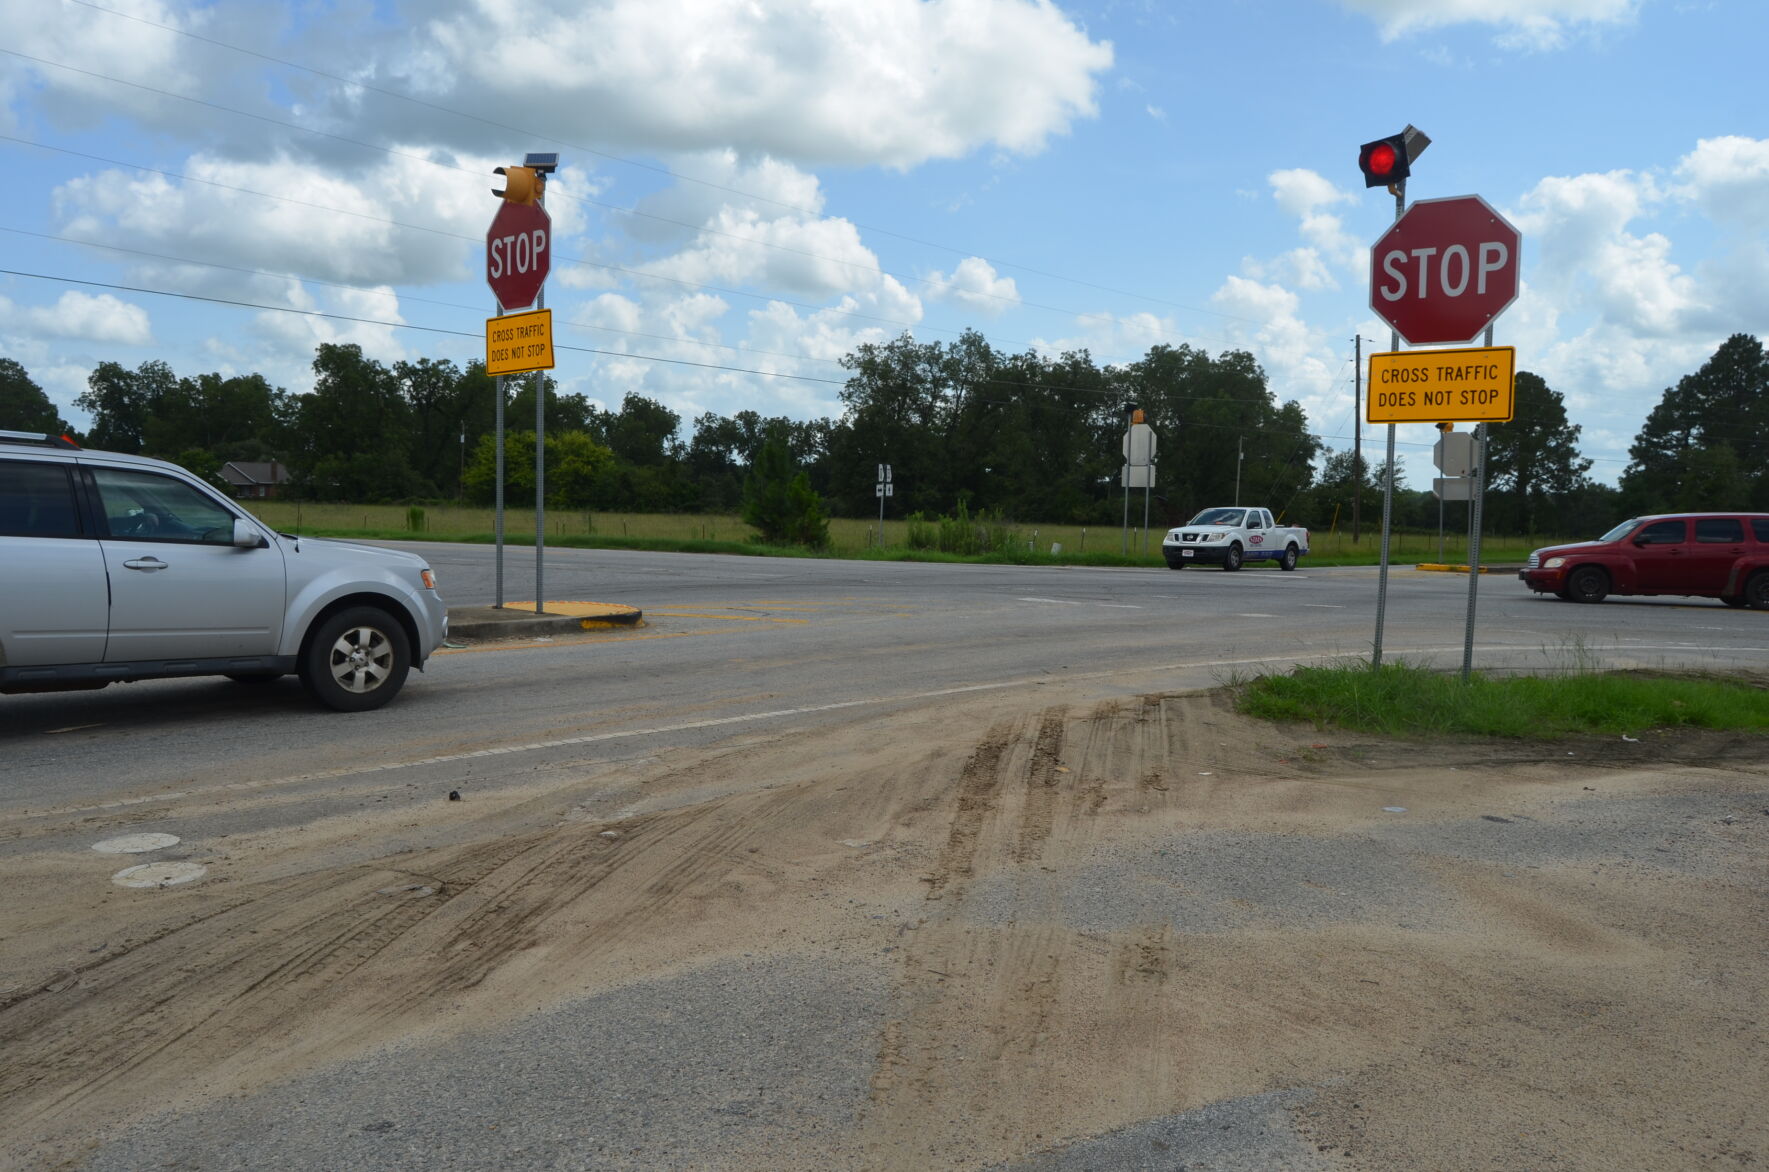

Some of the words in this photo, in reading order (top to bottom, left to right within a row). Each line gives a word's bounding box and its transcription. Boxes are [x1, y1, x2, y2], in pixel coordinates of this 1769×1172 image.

[490, 229, 546, 279] STOP
[1380, 242, 1508, 302] STOP
[492, 328, 514, 343] CROSS
[517, 323, 544, 340] TRAFFIC
[491, 349, 509, 362] DOES
[511, 346, 525, 359] NOT
[527, 343, 545, 358] STOP
[1381, 367, 1429, 384] CROSS
[1437, 364, 1498, 382] TRAFFIC
[1379, 391, 1416, 408] DOES
[1424, 391, 1453, 406] NOT
[1460, 389, 1499, 405] STOP
